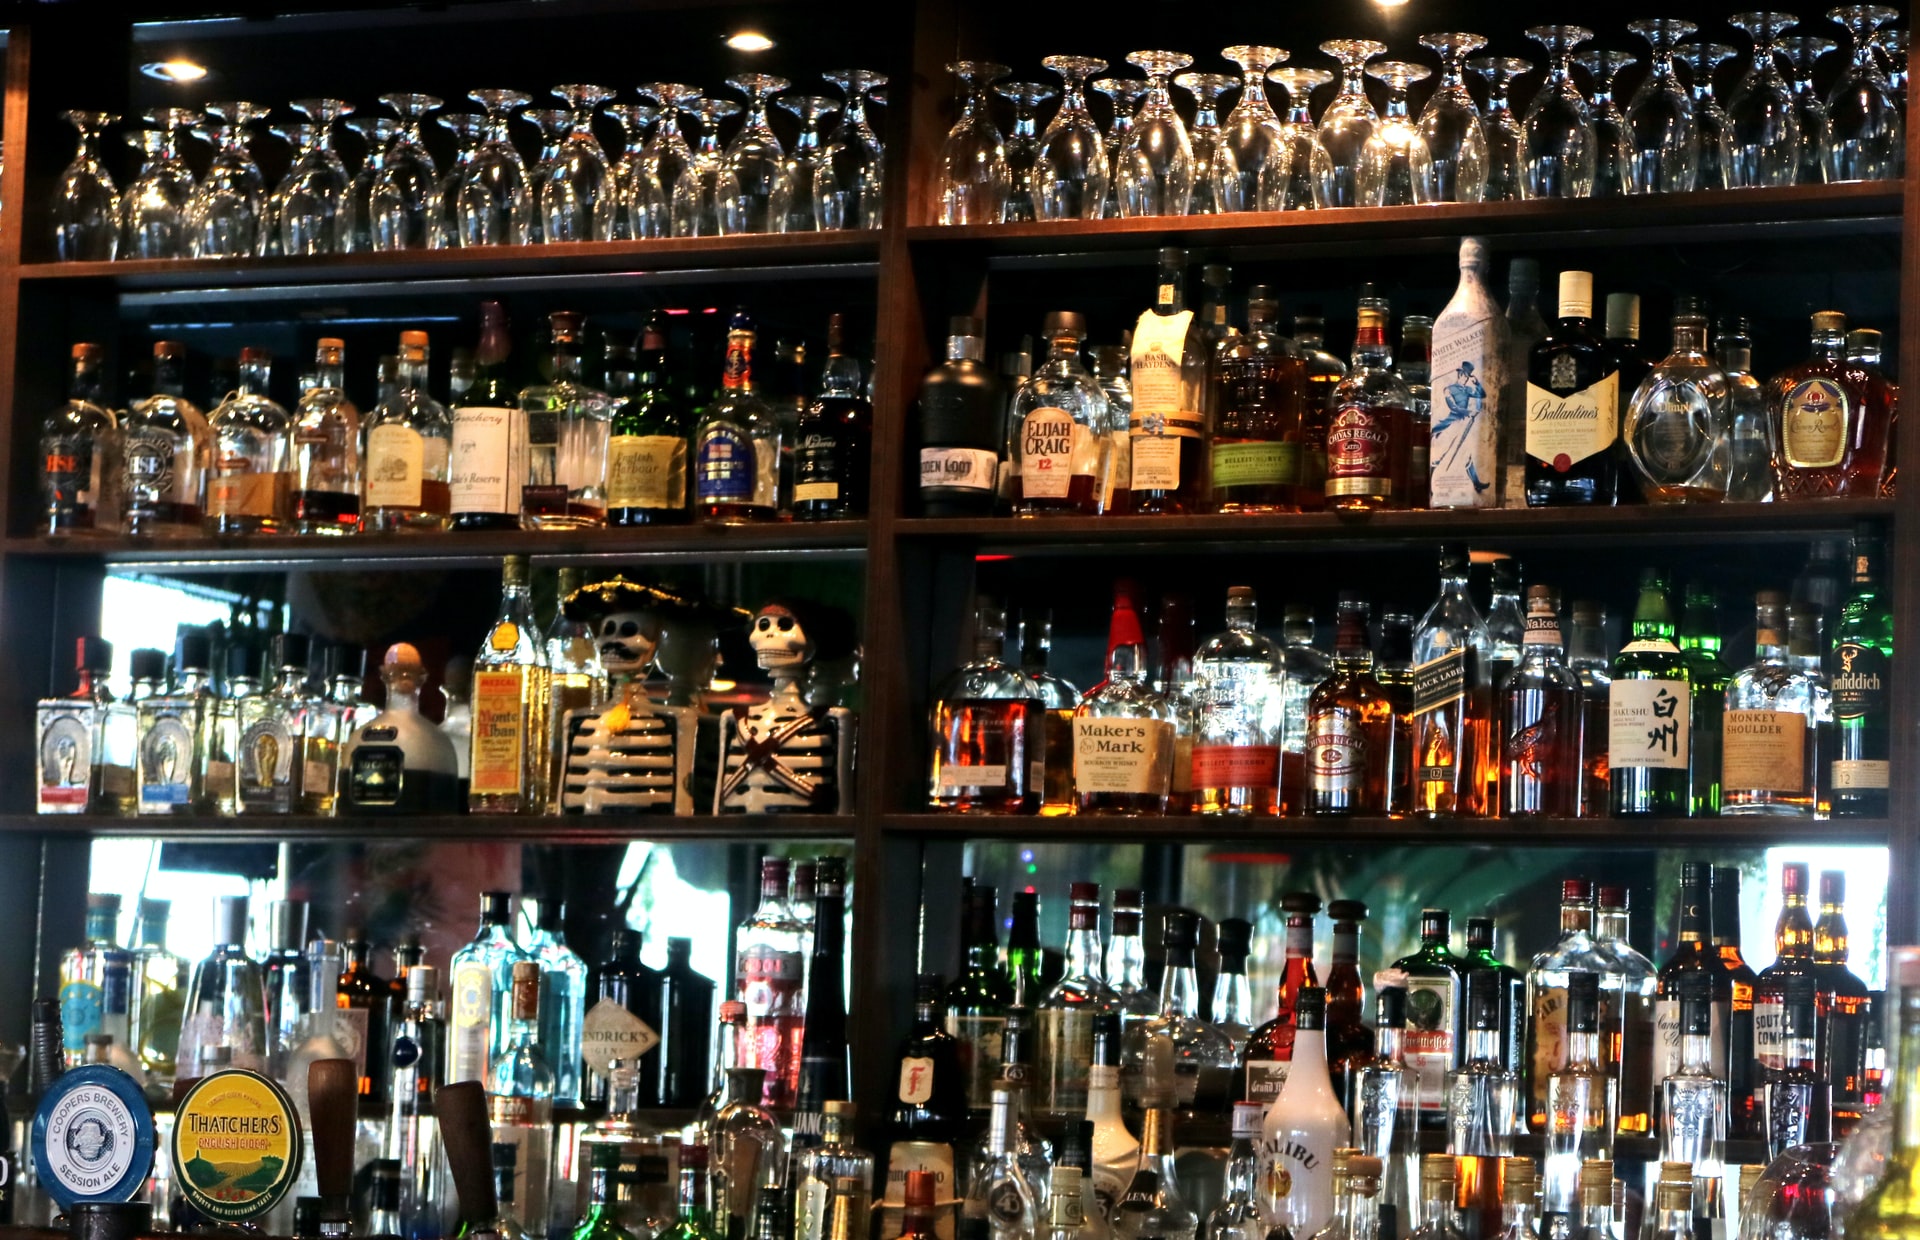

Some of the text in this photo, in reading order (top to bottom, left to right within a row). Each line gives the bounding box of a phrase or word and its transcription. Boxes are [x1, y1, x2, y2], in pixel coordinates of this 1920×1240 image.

[1432, 329, 1486, 357] WHITE WALKER
[1530, 400, 1599, 422] Ballantine's
[1027, 421, 1071, 438] ELIJAH
[1329, 429, 1382, 445] CHIVAS REGAL
[1025, 437, 1070, 456] CRAIG
[1038, 459, 1051, 470] 12
[1440, 665, 1465, 681] LABEL
[1648, 688, 1679, 758] 白州
[1730, 713, 1777, 723] MONKEY
[1079, 724, 1146, 738] Maker's
[1727, 725, 1783, 735] SHOULDER
[1096, 740, 1146, 754] Mark
[1308, 734, 1363, 750] CHIVAS REGAL
[1326, 751, 1336, 761] 12
[1840, 773, 1851, 785] 12
[1756, 1014, 1780, 1029] SOUT
[583, 1031, 649, 1043] ENDRICK'S
[53, 1092, 129, 1137] COOPERS BREWERY
[188, 1113, 281, 1134] THATCHERS
[199, 1137, 269, 1150] ENGLISH CIDER
[1262, 1138, 1320, 1171] ALIBU
[60, 1162, 121, 1188] SESSION ALE
[257, 1192, 273, 1207] TASTE
